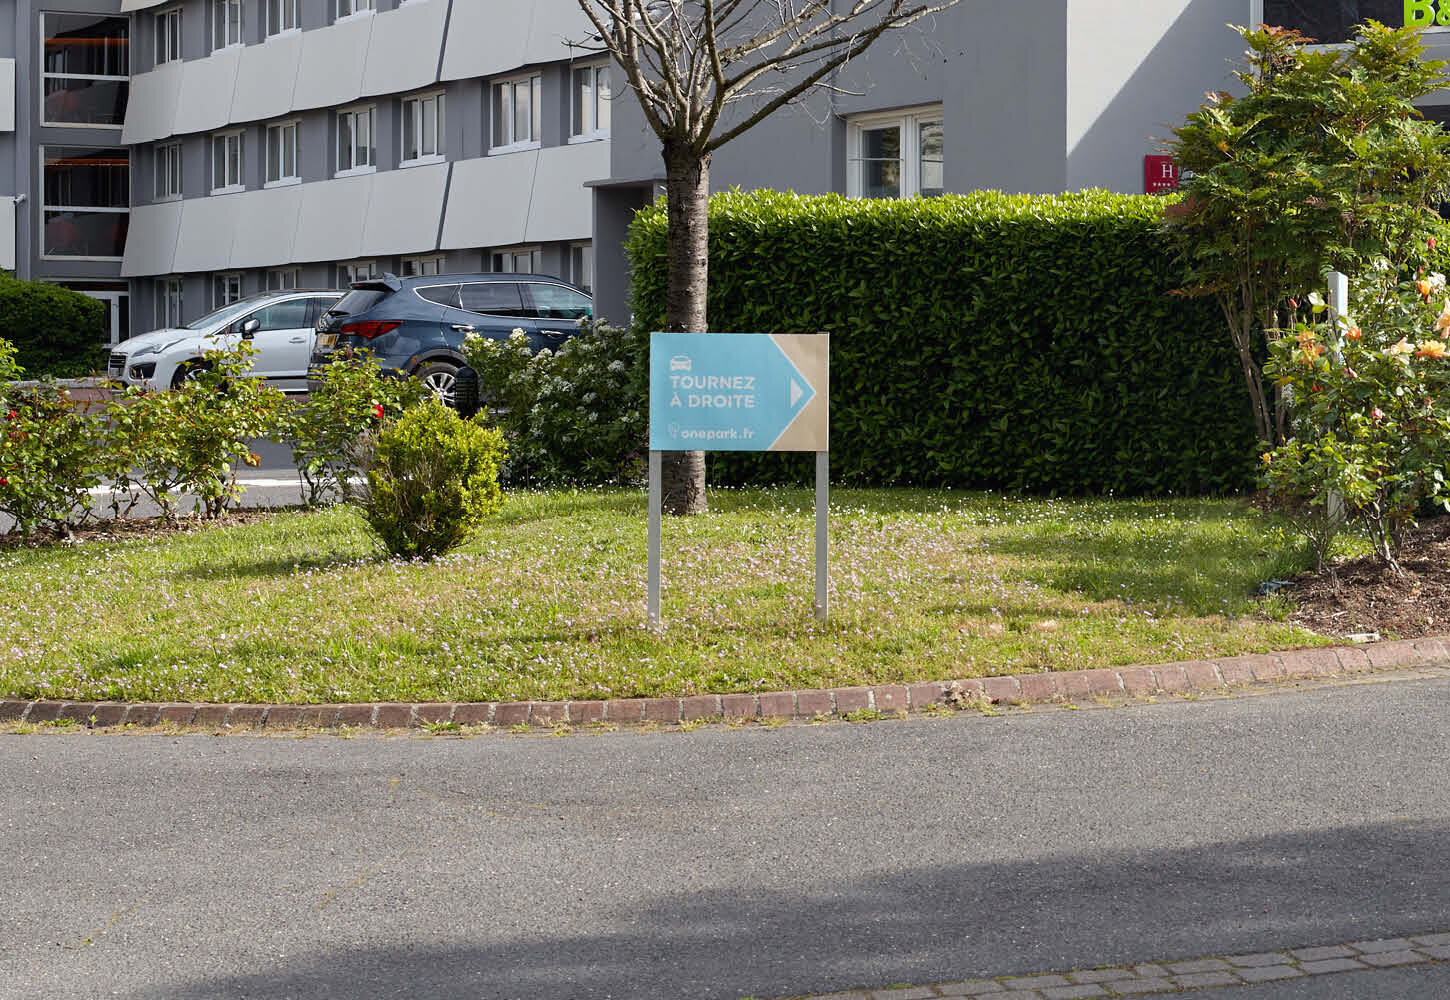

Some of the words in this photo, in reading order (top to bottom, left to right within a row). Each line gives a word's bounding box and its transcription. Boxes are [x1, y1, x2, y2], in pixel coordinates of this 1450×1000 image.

[1161, 164, 1173, 178] H
[669, 375, 756, 390] TOURNEZ
[669, 391, 682, 408] À
[687, 394, 756, 408] DROITE
[681, 427, 755, 440] onepark.fr
